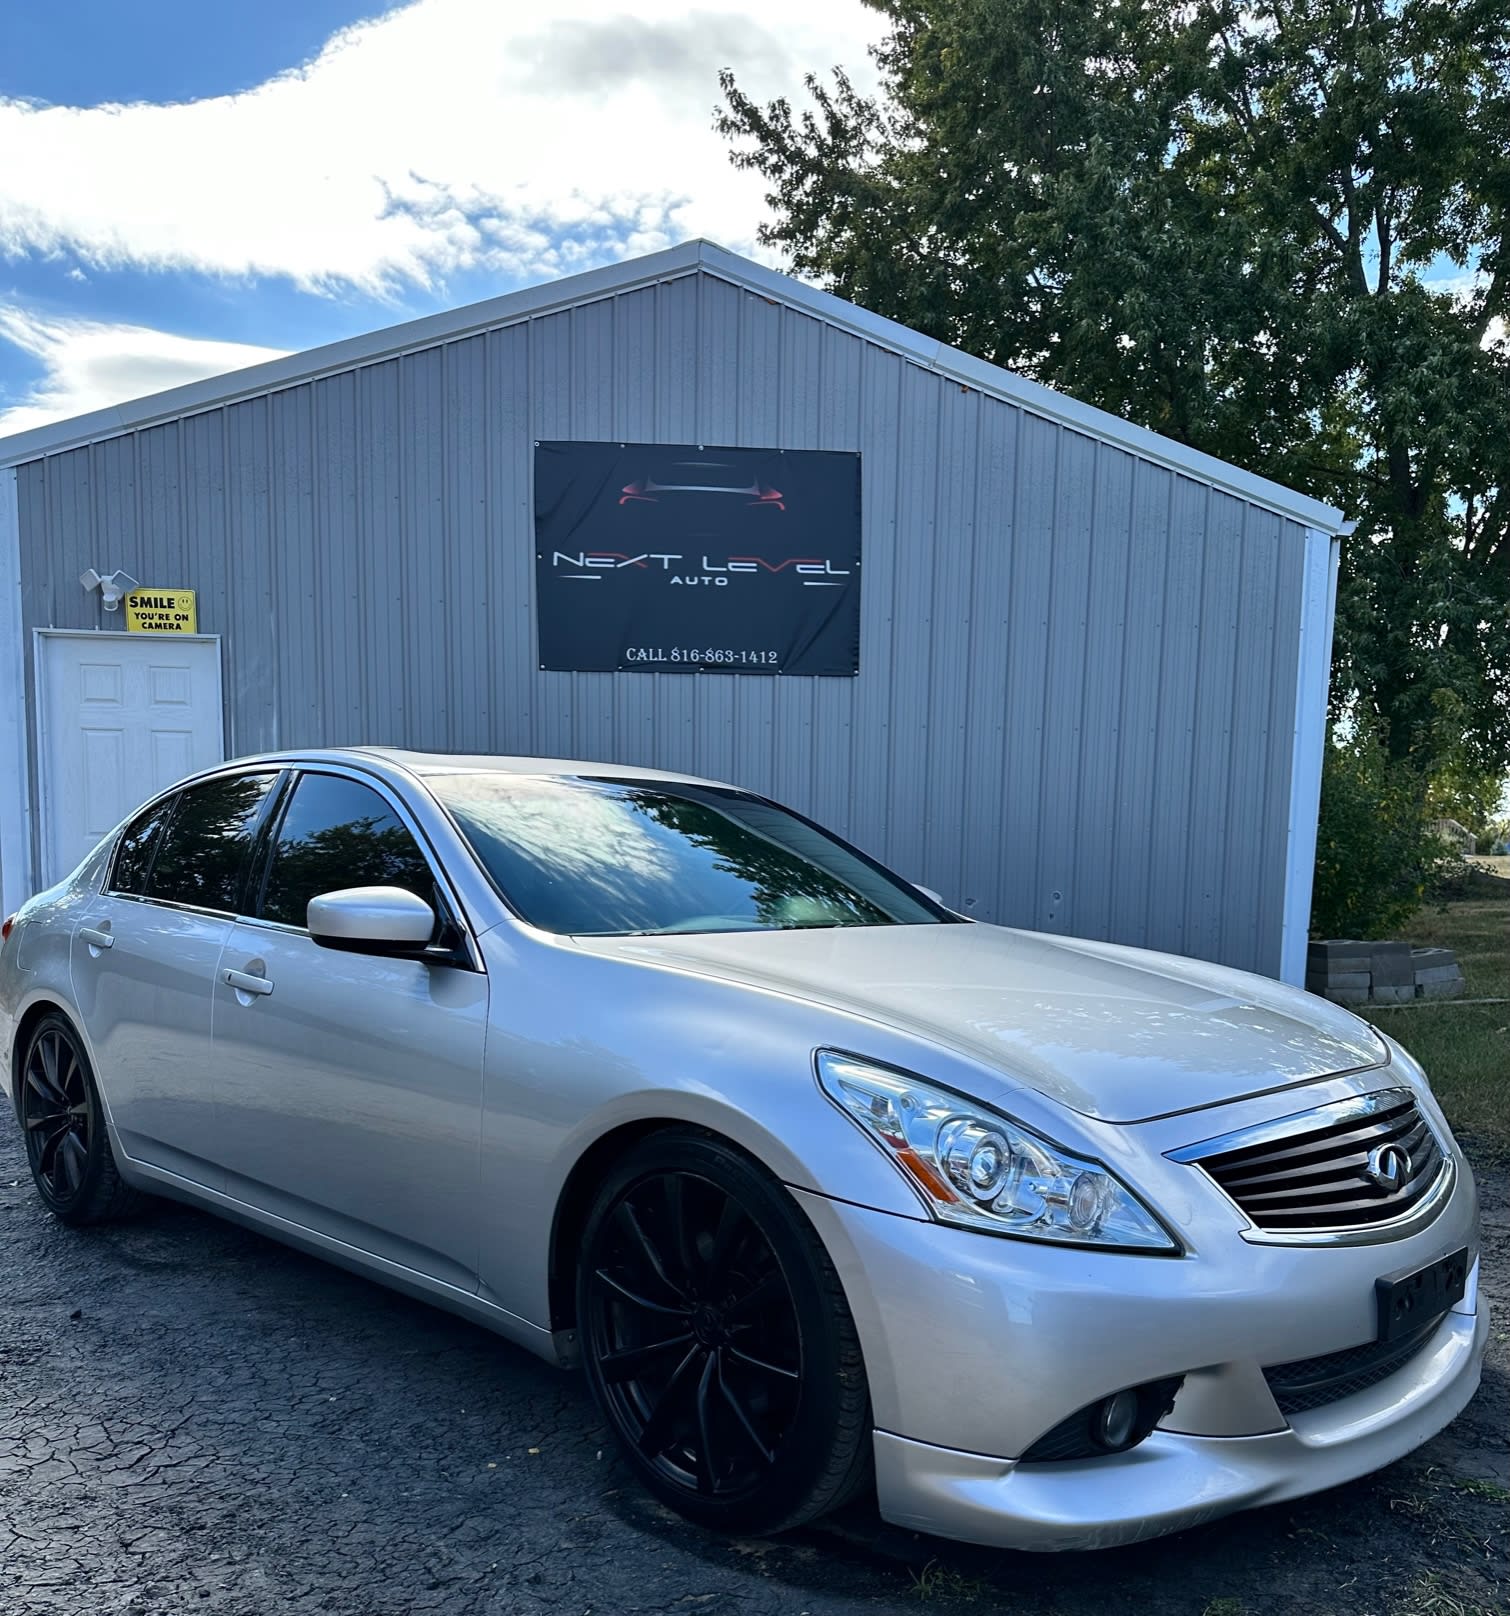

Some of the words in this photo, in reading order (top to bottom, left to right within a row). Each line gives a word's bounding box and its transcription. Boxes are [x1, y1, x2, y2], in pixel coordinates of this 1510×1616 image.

[552, 552, 682, 570] NEXT
[702, 555, 850, 575] LEVEL
[670, 575, 729, 586] AUTO
[129, 596, 176, 609] SMILE
[134, 612, 171, 621] YOU'RE
[174, 613, 189, 622] ON
[141, 622, 182, 631] CAMERA
[626, 647, 667, 662] CALL
[670, 646, 778, 664] 816-863-1412
